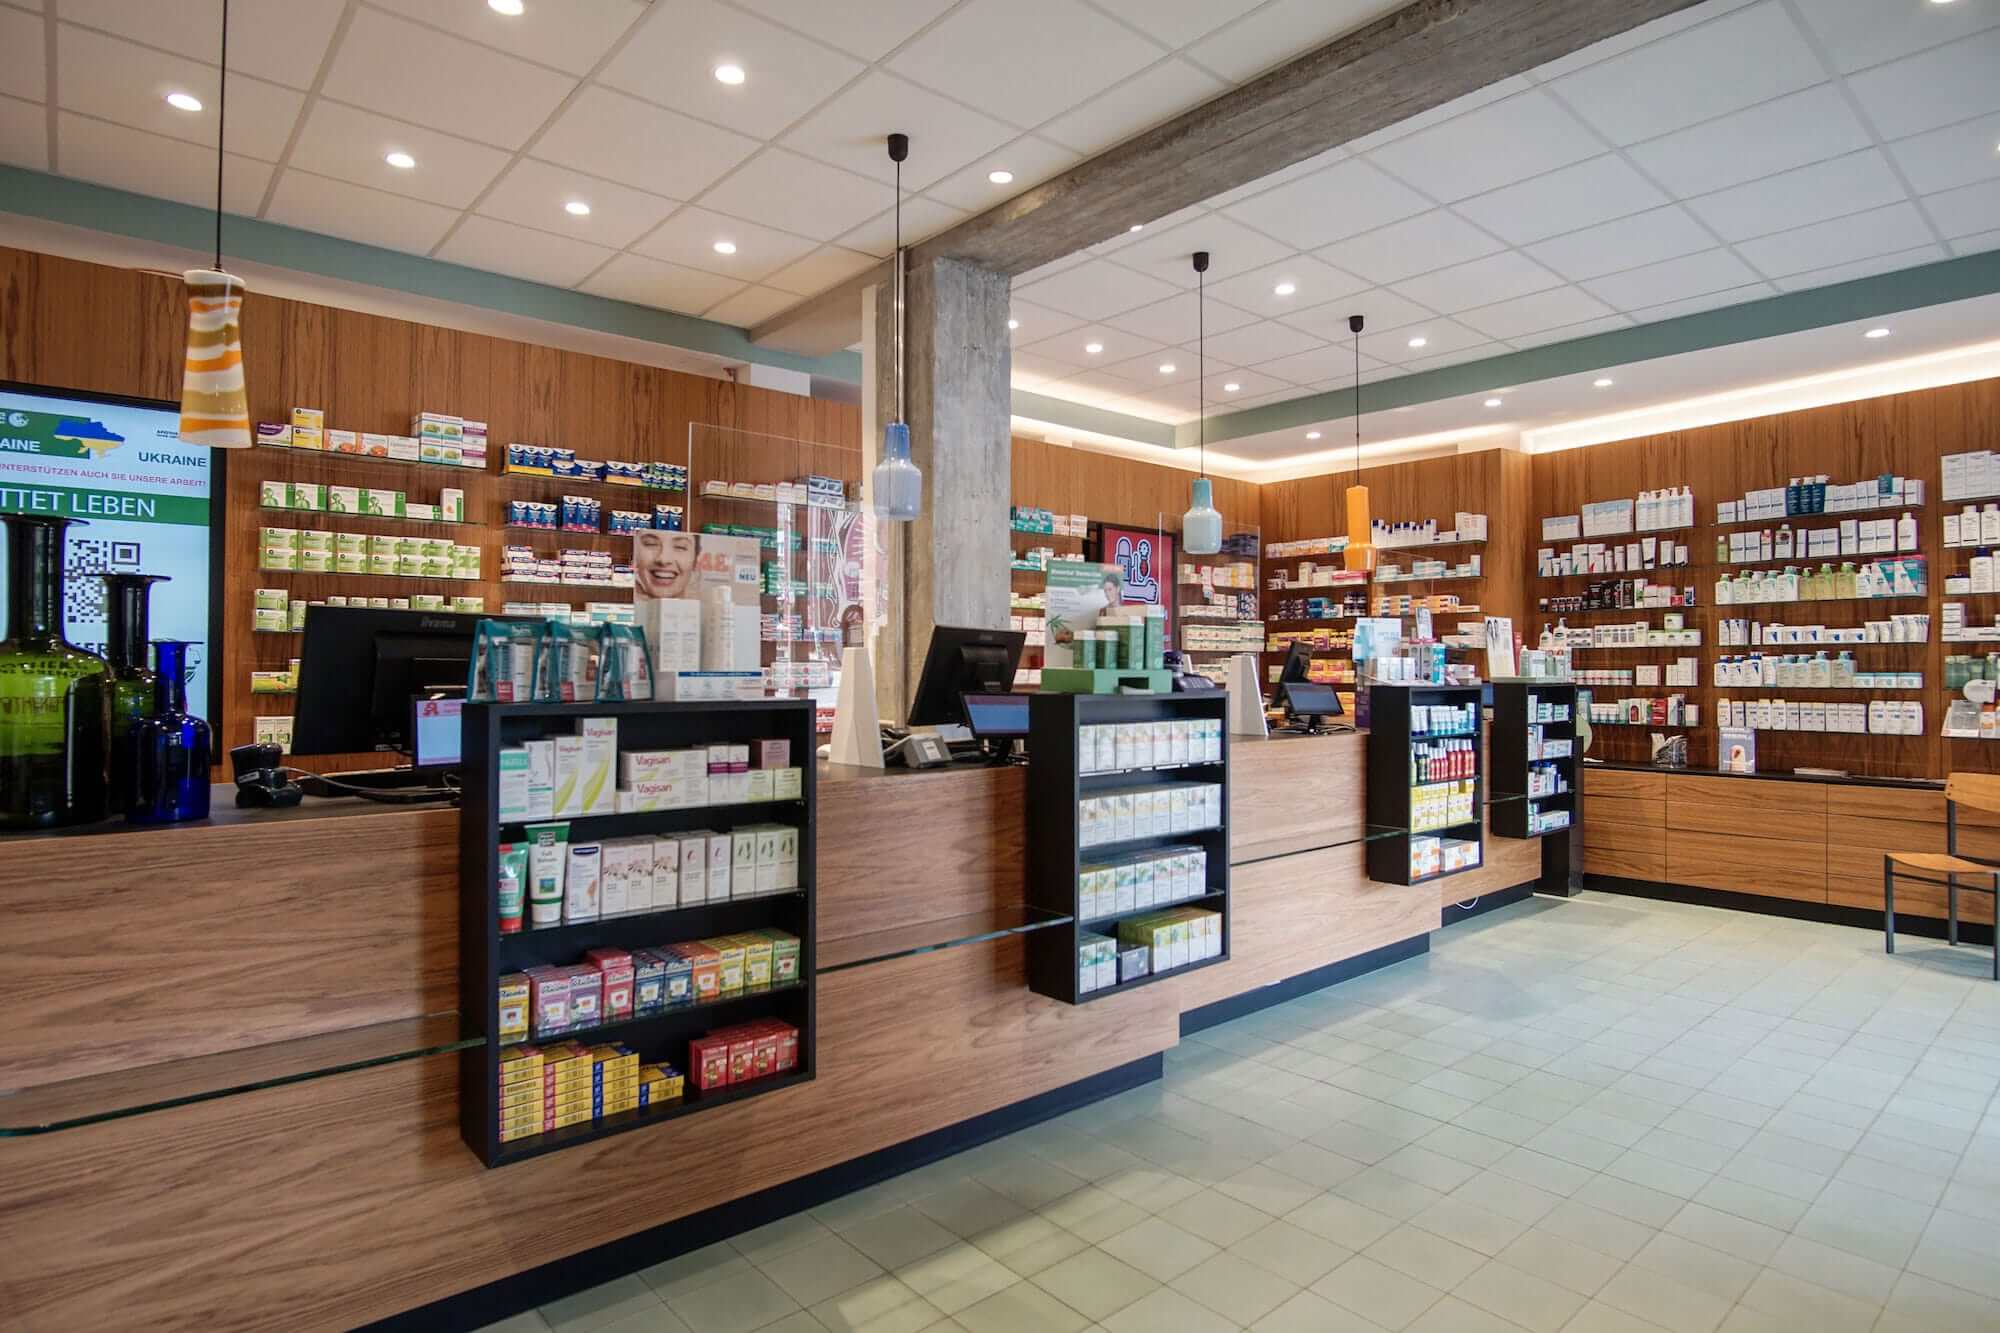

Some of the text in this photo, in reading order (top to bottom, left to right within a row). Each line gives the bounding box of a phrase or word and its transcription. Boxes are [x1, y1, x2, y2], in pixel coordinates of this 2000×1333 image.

[138, 451, 207, 468] UKRAINE
[0, 463, 207, 487] NTERSTÜTZEN AUCH SIE UNSERE ARBEIT!
[72, 493, 155, 518] LEBEN
[636, 755, 672, 768] Vagisan
[637, 784, 672, 796] Vagisan
